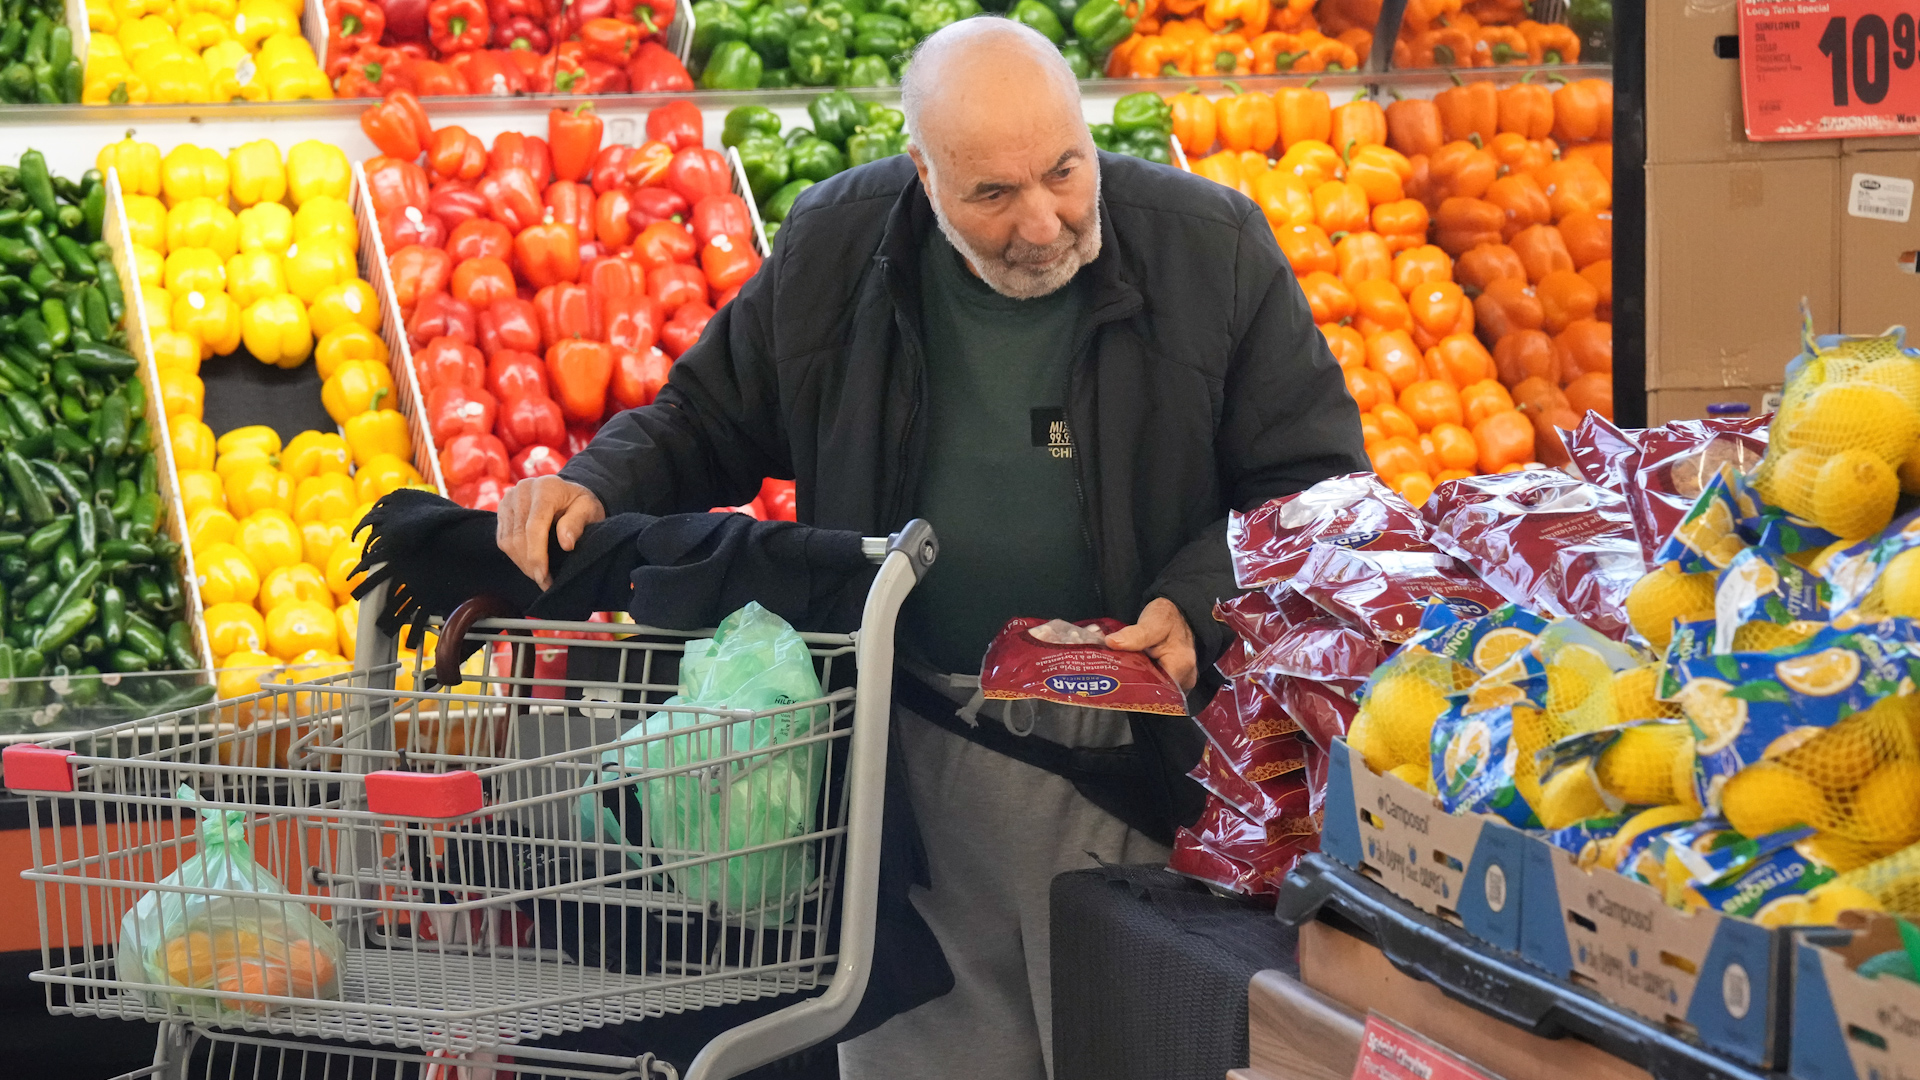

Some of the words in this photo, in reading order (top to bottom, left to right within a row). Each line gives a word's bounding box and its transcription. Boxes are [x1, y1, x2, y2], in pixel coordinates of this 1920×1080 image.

[1746, 7, 1770, 16] Long
[1773, 6, 1795, 15] Term
[1797, 3, 1830, 14] Special
[1755, 21, 1800, 30] SUNFLOWER
[1818, 14, 1890, 106] 10
[1445, 586, 1482, 594] Oriental
[1036, 654, 1078, 666] l'orientale
[1042, 666, 1058, 674] Mix
[1060, 664, 1080, 672] Style
[1052, 678, 1111, 690] CEDAR
[1385, 793, 1430, 835] Camposol
